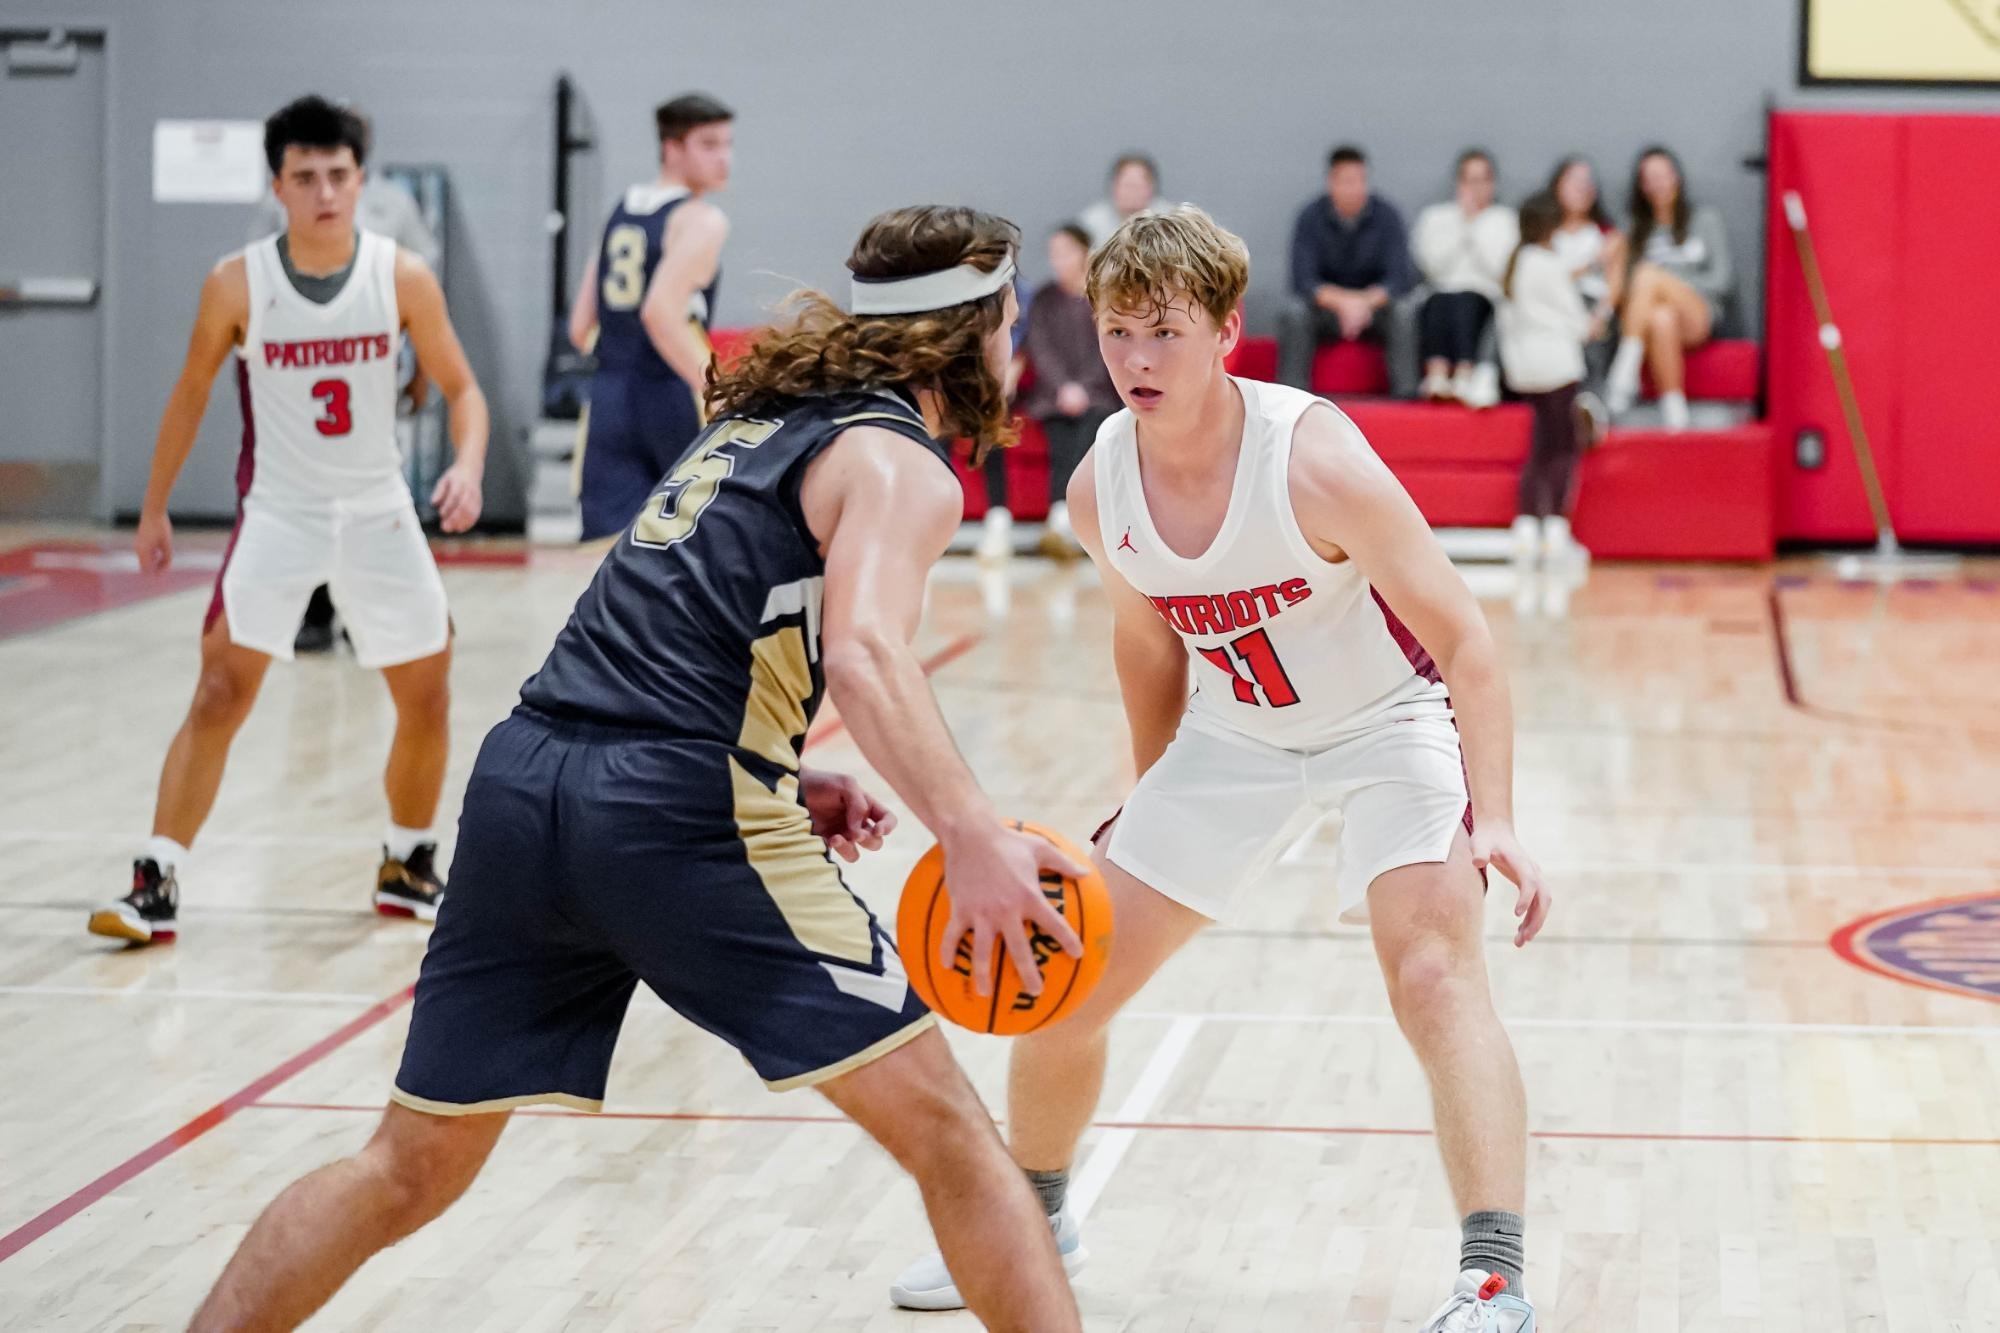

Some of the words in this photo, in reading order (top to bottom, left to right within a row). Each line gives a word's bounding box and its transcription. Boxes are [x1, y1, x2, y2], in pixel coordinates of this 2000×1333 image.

[602, 223, 648, 311] 3
[263, 333, 390, 369] PATRIOTS
[311, 378, 353, 437] 3
[630, 417, 785, 551] 5
[1196, 627, 1301, 708] 11
